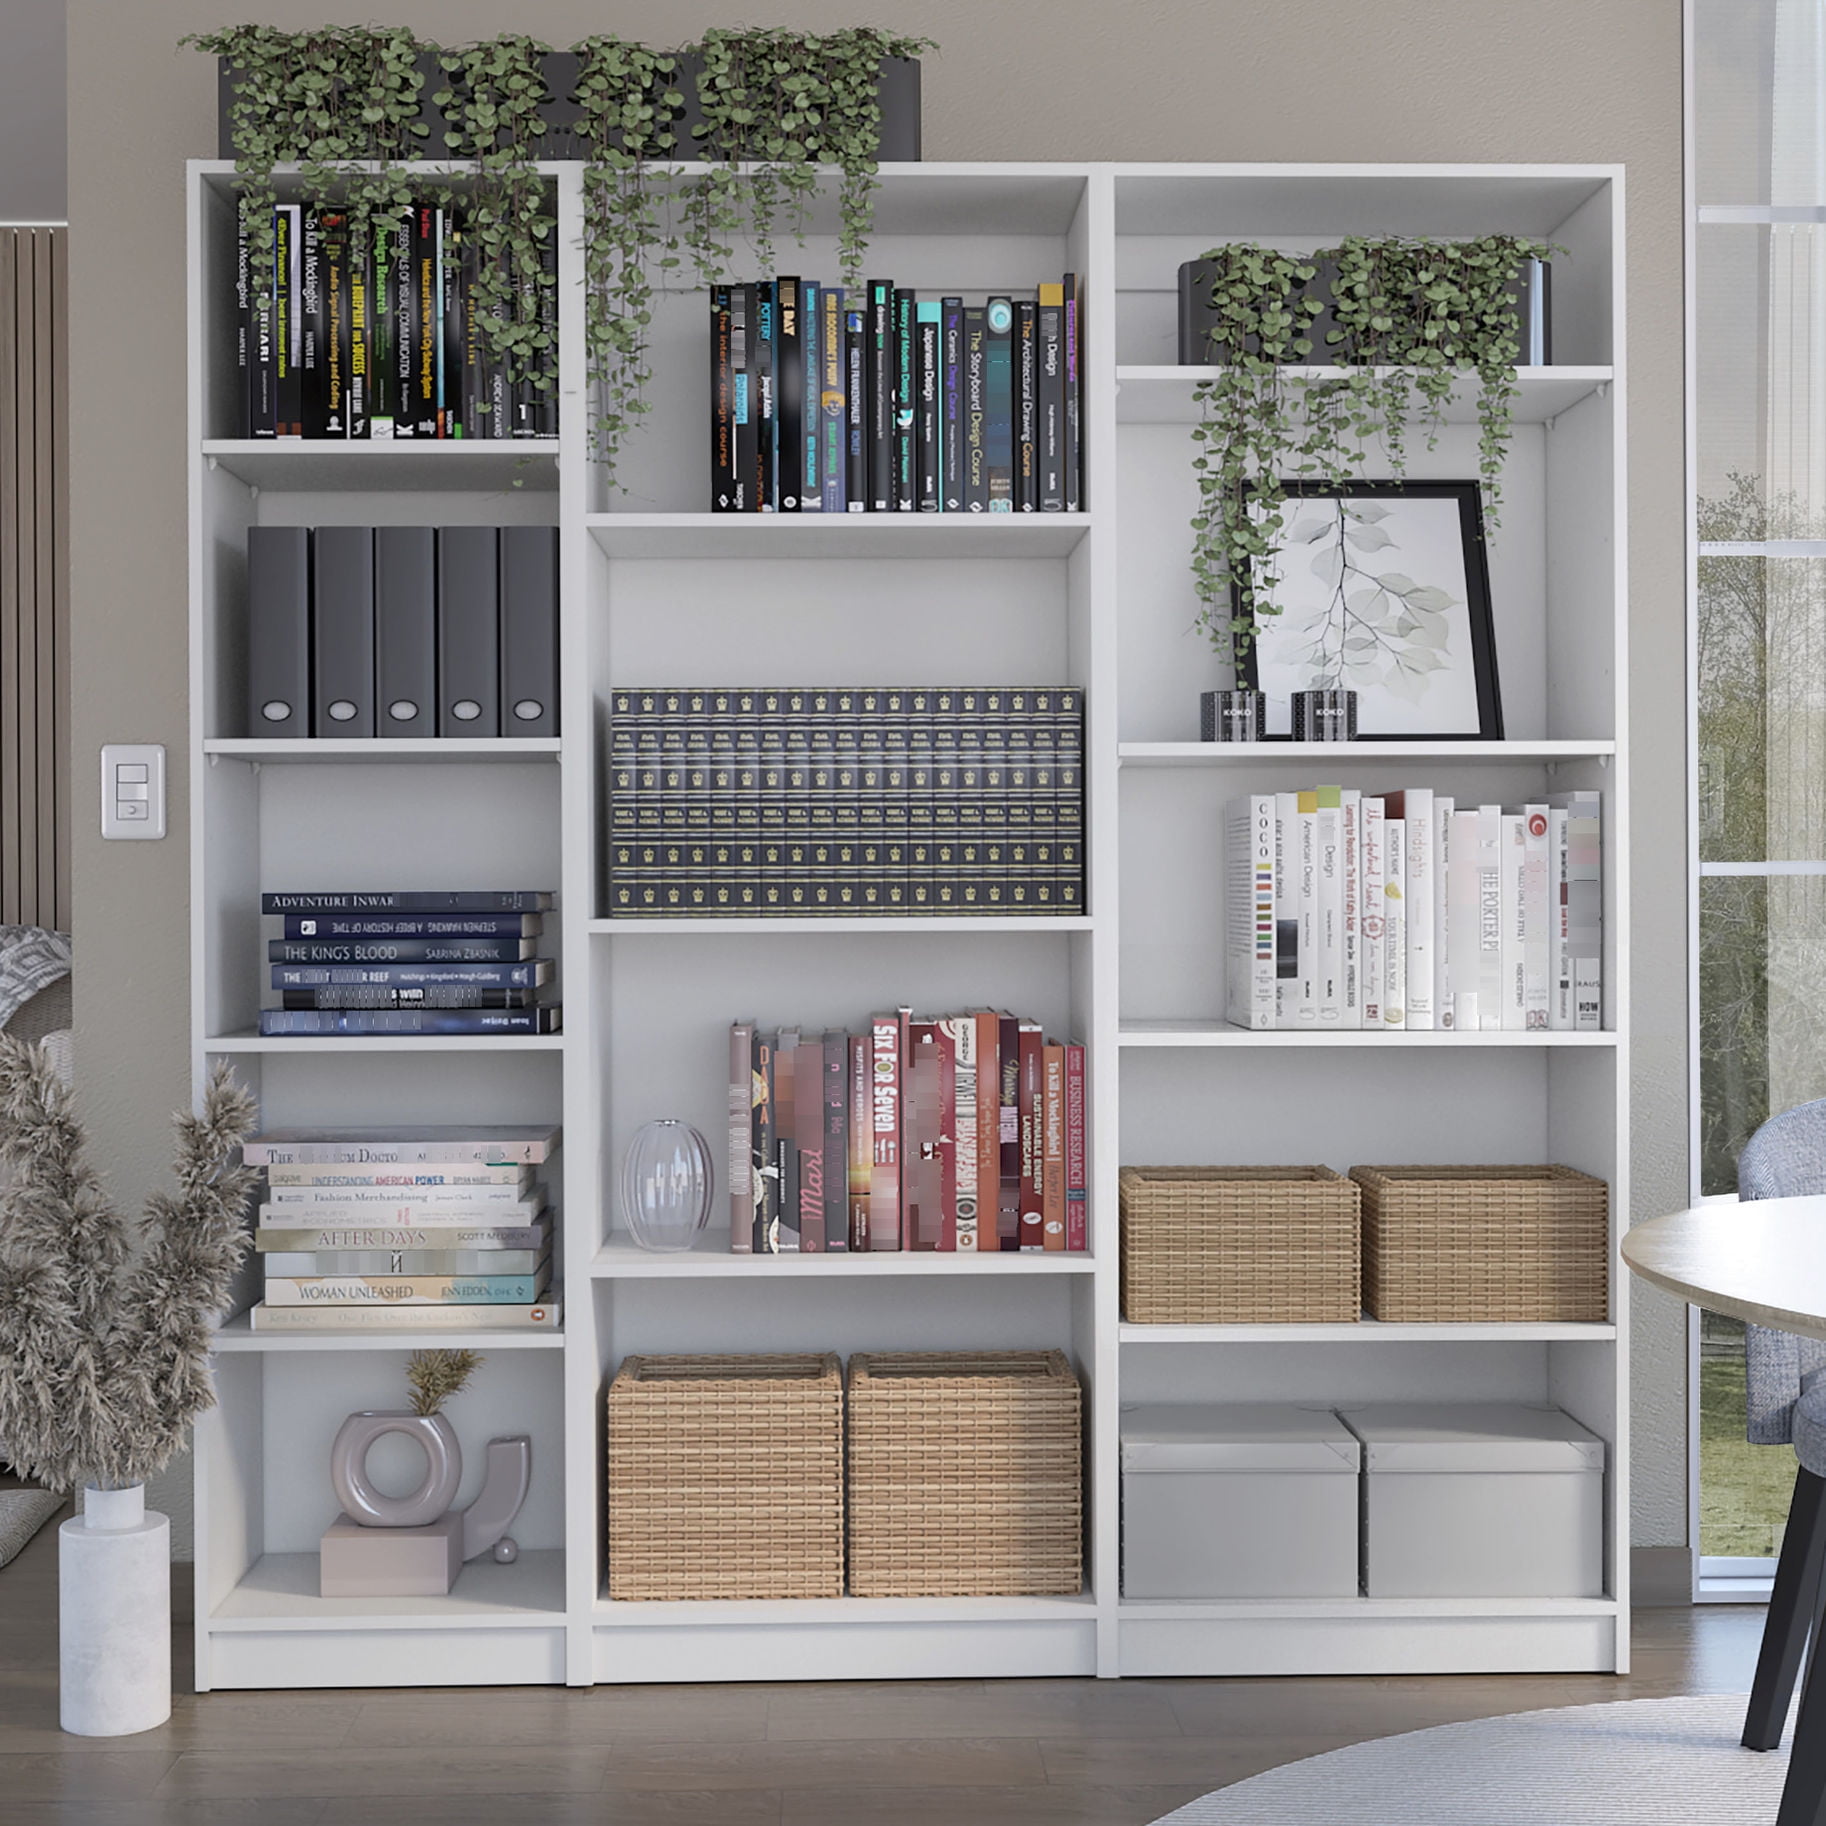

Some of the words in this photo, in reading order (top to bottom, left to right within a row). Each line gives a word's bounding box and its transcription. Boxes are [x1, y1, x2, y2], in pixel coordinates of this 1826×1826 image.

[305, 218, 317, 230] To
[421, 209, 430, 222] Paul
[306, 232, 317, 246] Kill
[374, 226, 388, 263] Design
[235, 247, 247, 308] Mockingbird
[302, 255, 318, 313] Mockingbird
[330, 266, 339, 289] Audio
[400, 271, 409, 282] OF
[422, 259, 432, 286] Helvetica
[376, 265, 388, 314] Research
[400, 284, 409, 310] VISUAL
[423, 287, 431, 298] and
[329, 291, 339, 317] Signal
[423, 299, 432, 308] the
[423, 309, 431, 323] New
[899, 299, 910, 328] History
[260, 292, 269, 362] FRRARI
[423, 324, 432, 338] York
[720, 313, 728, 332] the
[761, 302, 771, 340] POTTERY
[783, 310, 795, 336] DAY
[875, 306, 884, 334] drawing
[949, 315, 957, 328] The
[1022, 320, 1033, 338] The
[305, 331, 314, 354] HARPER
[329, 319, 339, 362] Processing
[399, 312, 410, 377] COMMUNICATION
[420, 339, 432, 350] City
[901, 329, 910, 338] of
[970, 330, 982, 351] The
[353, 344, 365, 374] SUCCESS
[720, 335, 728, 380] interior
[851, 348, 860, 368] HELEN
[901, 340, 909, 372] Modern
[922, 328, 934, 369] Japanese
[948, 330, 958, 363] Ceramics
[278, 355, 286, 378] rates
[306, 355, 314, 368] LEE
[330, 363, 339, 379] and
[421, 351, 432, 375] Subway
[1022, 339, 1032, 400] Architectural
[1046, 344, 1057, 376] Design
[421, 377, 432, 398] System
[494, 374, 502, 402] ANDREW
[900, 374, 909, 402] Design
[922, 371, 935, 401] Design
[946, 365, 958, 390] Design
[969, 352, 982, 410] Storyboard
[329, 380, 340, 409] Coding
[718, 383, 728, 423] design
[735, 376, 746, 423] Polaroids
[851, 370, 860, 424] FRANKENTHALER
[948, 392, 958, 419] Course
[969, 413, 982, 447] Design
[1021, 402, 1032, 441] Drawing
[720, 426, 728, 467] course
[1023, 442, 1032, 476] Course
[971, 449, 982, 486] Course
[1344, 804, 1355, 827] Learning
[1259, 804, 1268, 857] COCO
[1303, 821, 1312, 864] American
[1391, 828, 1399, 858] AUTHOR'S
[1409, 819, 1426, 878] Hindsights
[1324, 845, 1335, 878] Design
[1346, 868, 1355, 877] The
[1391, 859, 1399, 875] NAME
[1302, 866, 1312, 897] Design
[1347, 878, 1355, 893] Work
[272, 896, 349, 907] ADVENTURE
[1344, 900, 1355, 915] Kathy
[1518, 908, 1525, 918] OF
[332, 923, 350, 933] TIME
[352, 923, 361, 933] OF
[363, 923, 393, 933] HISTORY
[416, 922, 424, 933] A
[1389, 917, 1397, 939] YOUR
[1482, 892, 1499, 939] PORTER
[285, 946, 306, 960] THE
[311, 945, 350, 960] KING'S
[354, 945, 397, 959] BLOOD
[426, 949, 461, 959] SABRINA
[1389, 939, 1397, 960] TIME
[284, 972, 300, 982] THE
[369, 972, 389, 982] REEF
[1389, 970, 1397, 990] NOW
[1579, 1002, 1597, 1012] HOW
[856, 1045, 864, 1074] MISFITS
[1048, 1062, 1058, 1072] To
[760, 1045, 769, 1124] DADA
[856, 1076, 864, 1091] AND
[1048, 1073, 1059, 1090] Kill
[856, 1093, 864, 1122] HEROES
[1070, 1076, 1082, 1126] BUSINESS
[1033, 1094, 1042, 1156] SUSTAINABLE
[1046, 1099, 1060, 1155] Mockingbird
[267, 1148, 293, 1164] THE
[1023, 1115, 1031, 1177] LANDSCAPES
[1070, 1128, 1083, 1184] RESEARCH
[312, 1176, 374, 1186] UNDERSTANDING
[376, 1176, 414, 1186] AMERICAN
[415, 1176, 444, 1185] POWER
[1033, 1158, 1042, 1195] ENERGY
[315, 1193, 352, 1201] Fashion
[355, 1193, 428, 1202] Merchandising
[319, 1231, 377, 1246] AFTER
[382, 1231, 426, 1243] DAYS
[457, 1233, 484, 1241] SCOTT
[299, 1286, 347, 1299] WOMAN
[350, 1285, 413, 1299] UNLEASHED
[441, 1286, 462, 1299] JENN
